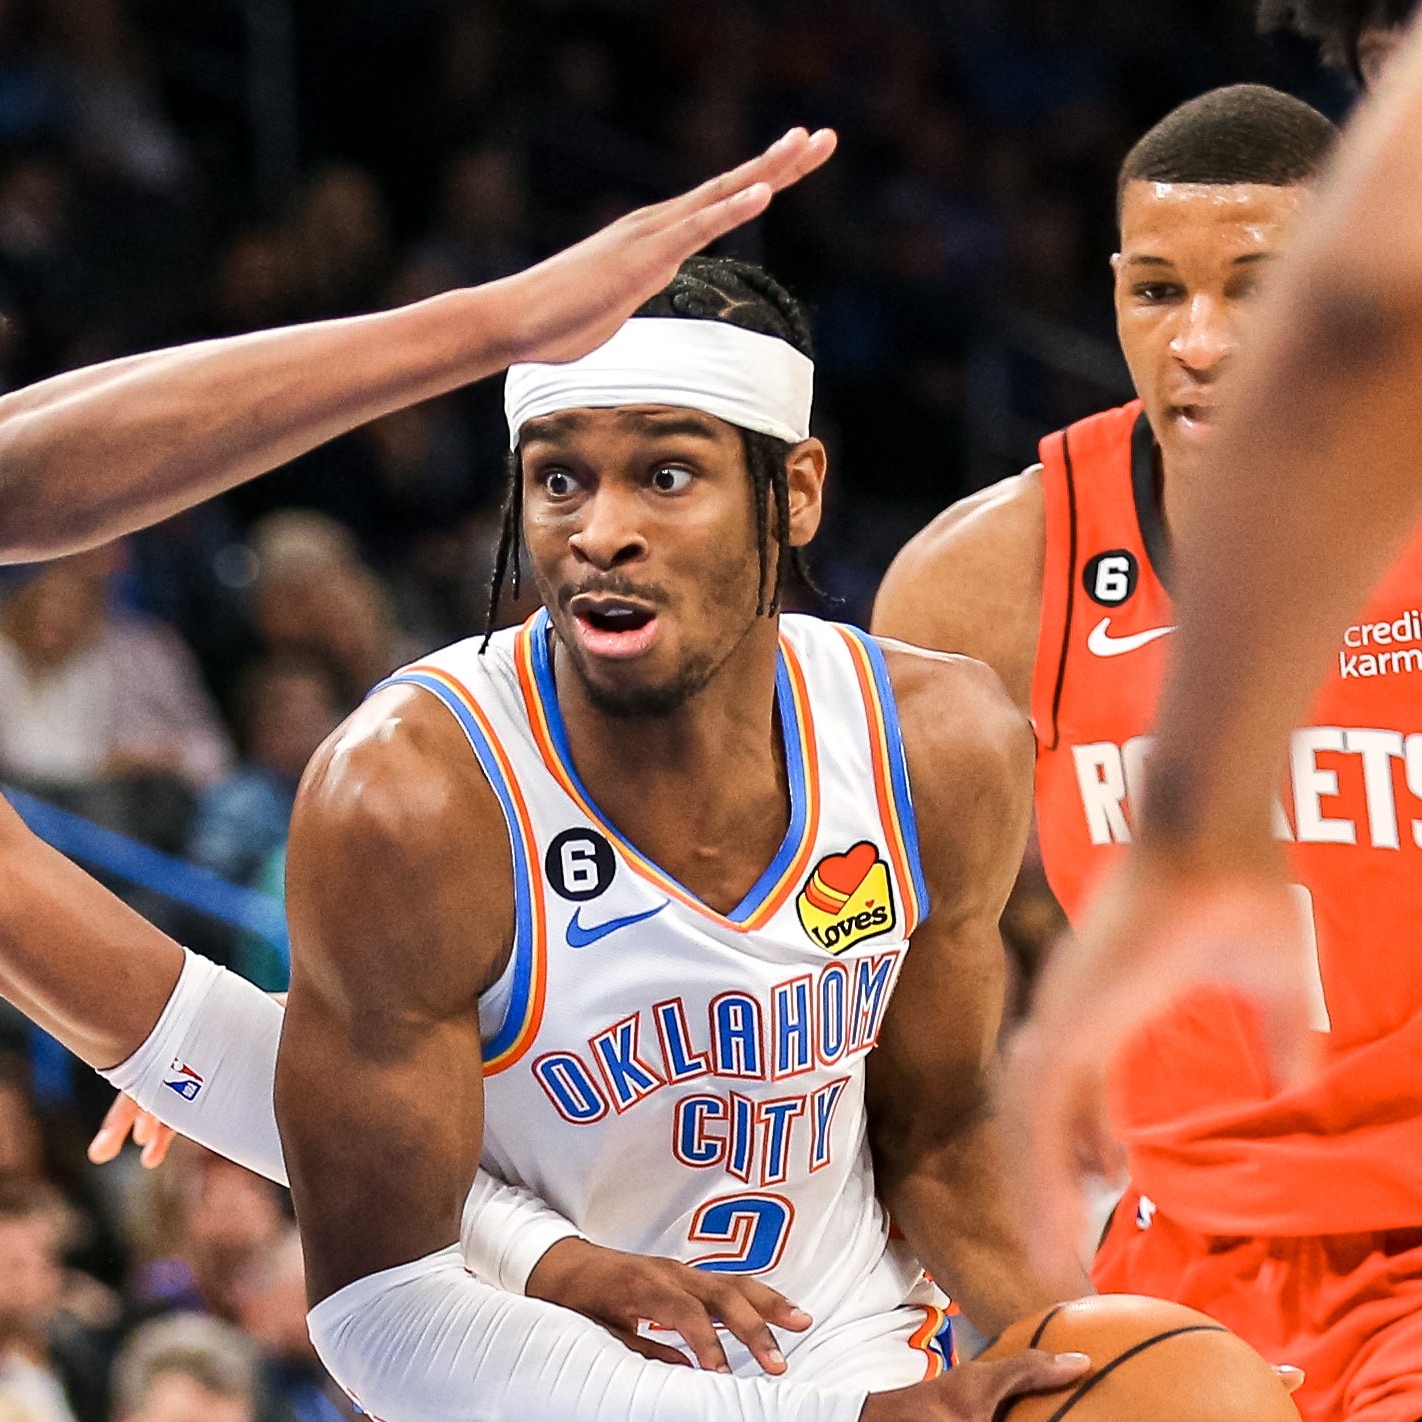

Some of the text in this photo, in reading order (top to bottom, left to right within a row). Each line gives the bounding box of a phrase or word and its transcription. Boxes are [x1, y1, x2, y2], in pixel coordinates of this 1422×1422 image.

[1094, 556, 1129, 601] 6
[560, 839, 600, 893] 6
[532, 949, 900, 1125] OKLAHOM
[673, 1075, 852, 1188] CITY
[684, 1192, 795, 1276] 2
